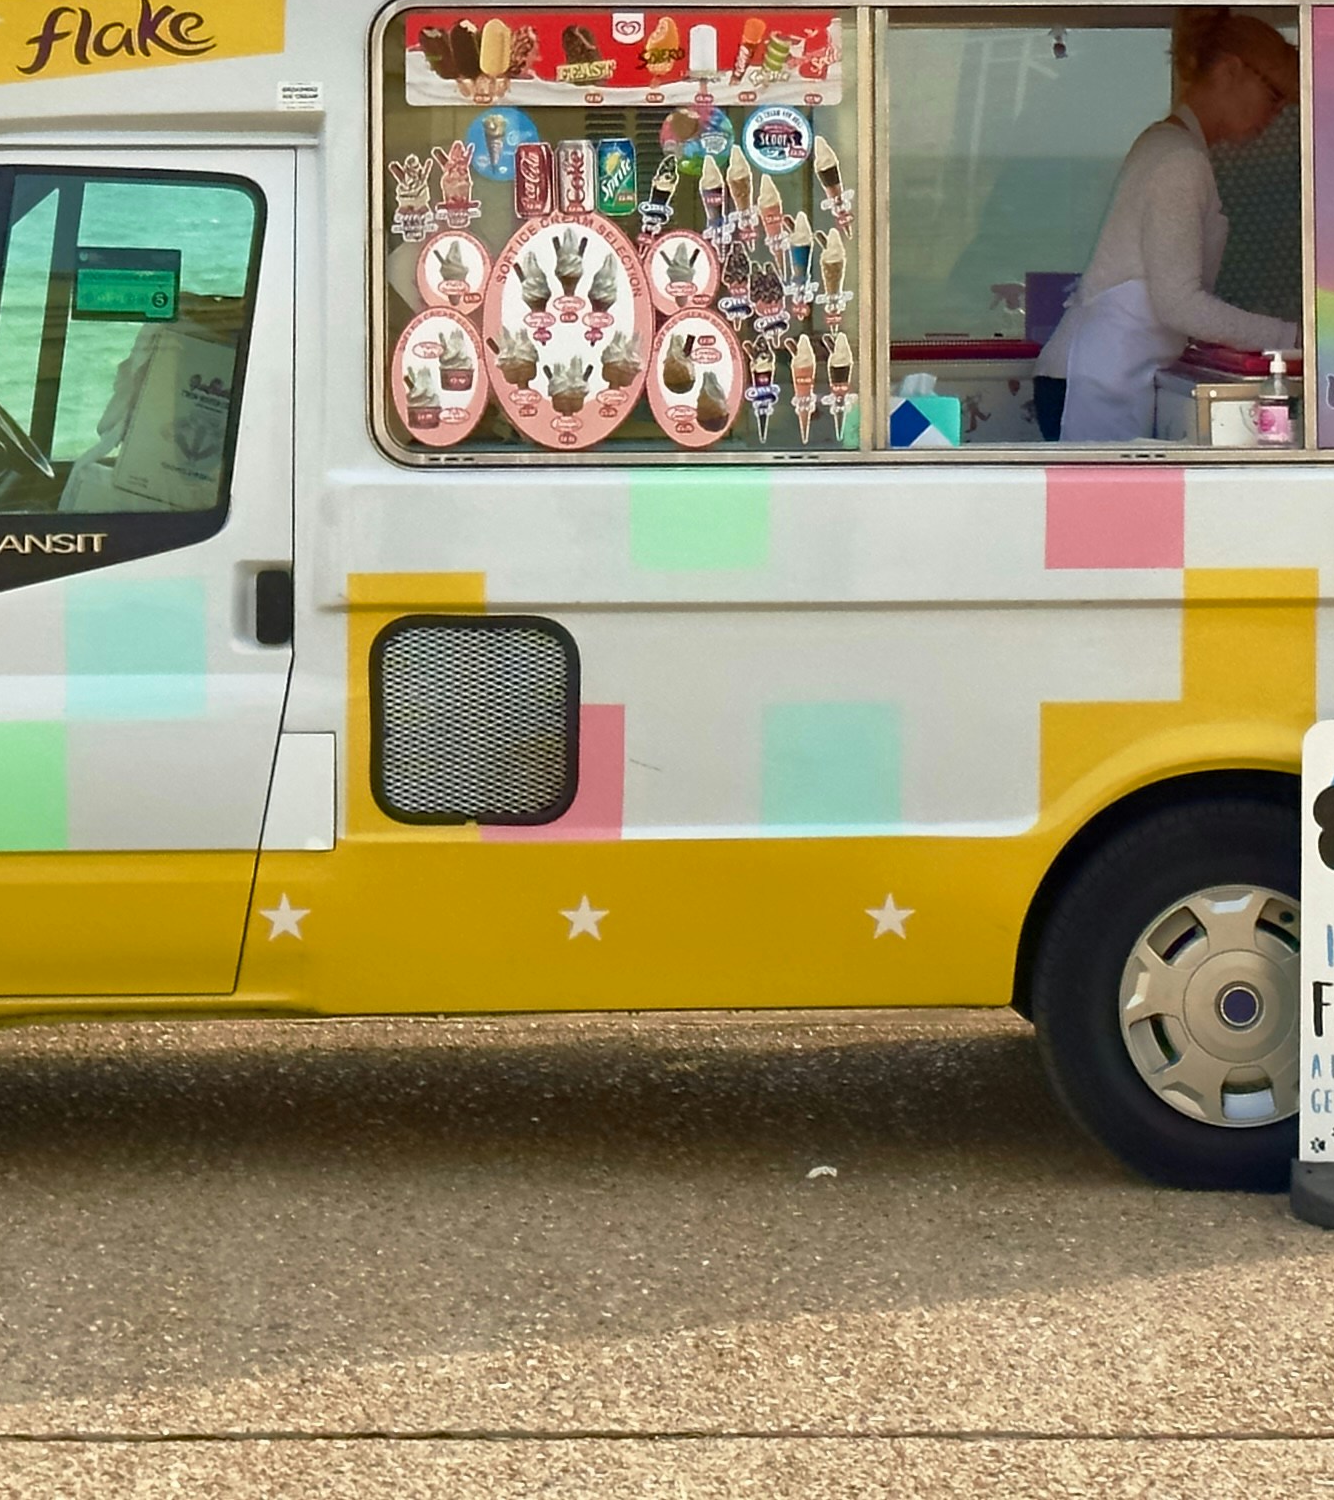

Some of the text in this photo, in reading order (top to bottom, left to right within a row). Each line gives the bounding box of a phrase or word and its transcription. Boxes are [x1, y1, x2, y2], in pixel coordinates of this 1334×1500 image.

[601, 158, 632, 203] Sprite
[495, 245, 518, 286] SOFT
[514, 223, 537, 247] ICE
[538, 212, 594, 229] CREAM
[595, 222, 643, 299] SELECTION
[1311, 1054, 1322, 1079] A
